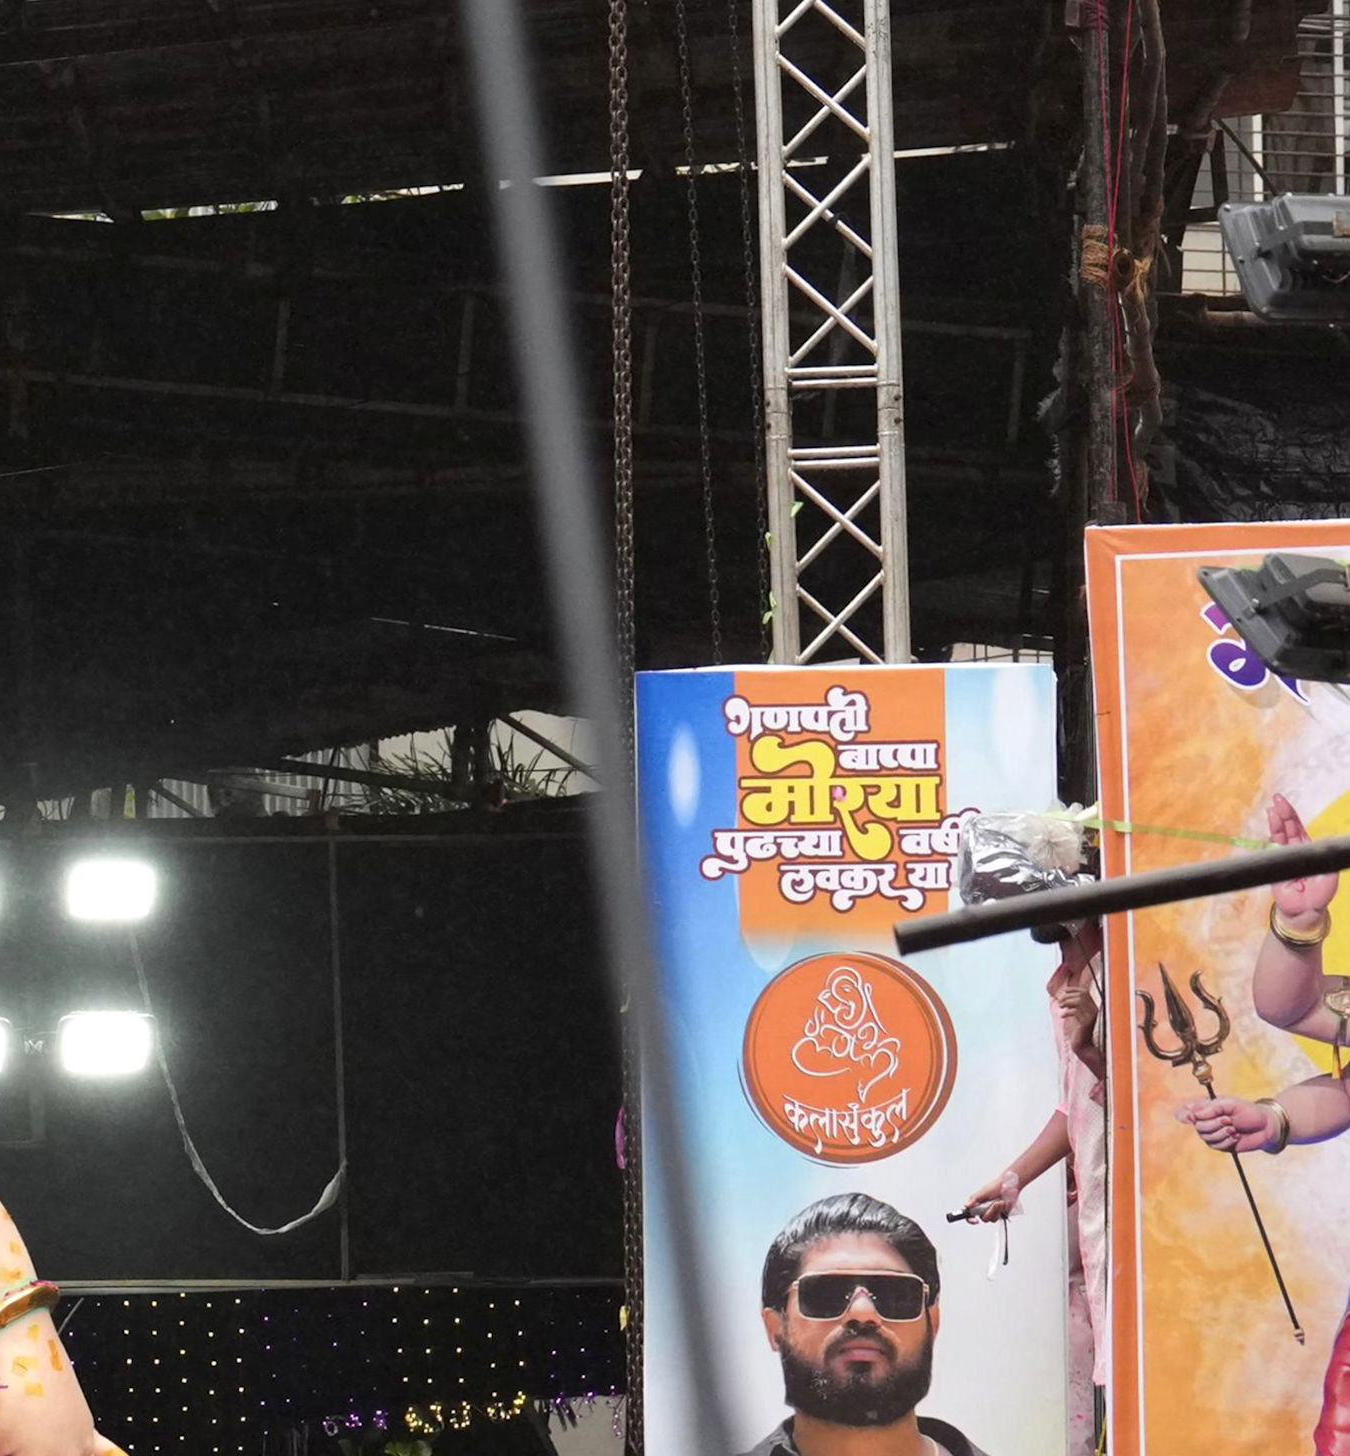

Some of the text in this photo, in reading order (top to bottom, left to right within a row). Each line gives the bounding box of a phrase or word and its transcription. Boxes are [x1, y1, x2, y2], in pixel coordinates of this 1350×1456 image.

[725, 686, 869, 741] गणपती
[837, 742, 939, 771] बाप्पा
[740, 734, 942, 860] मोरया
[700, 829, 844, 878] पुढच्या
[779, 861, 952, 912] लवकर या
